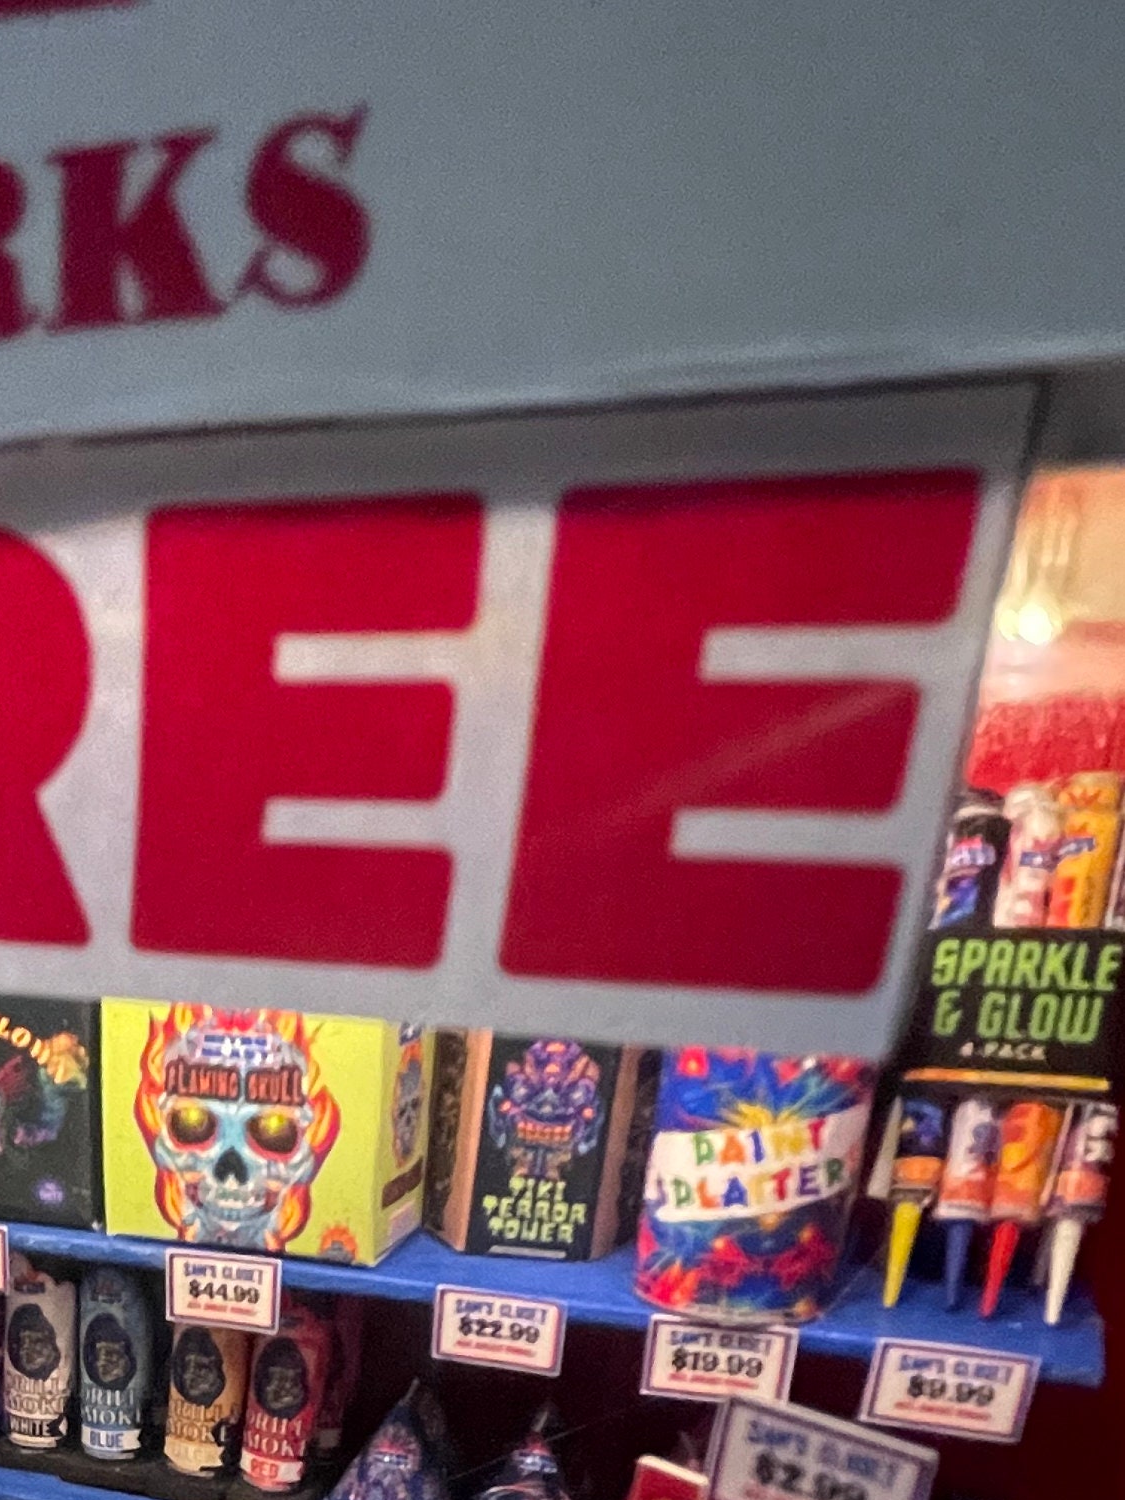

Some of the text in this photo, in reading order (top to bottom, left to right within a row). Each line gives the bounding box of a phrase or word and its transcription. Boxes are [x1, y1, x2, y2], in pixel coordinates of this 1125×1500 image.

[930, 938, 1124, 992] SPARKLE
[932, 991, 1104, 1045] & GLOW
[167, 1062, 303, 1103] FLAMING SKULL
[693, 1119, 826, 1166] PAINT
[509, 1177, 566, 1202] TIKI
[483, 1195, 587, 1225] TERROR
[489, 1217, 574, 1244] TOWER
[188, 1279, 260, 1305] $44.99
[458, 1317, 540, 1344] $22.99
[671, 1348, 763, 1377] $19.99
[907, 1375, 995, 1406] $9.99
[10, 1416, 50, 1436] WHITE
[89, 1430, 123, 1448] BLUE
[250, 1457, 279, 1478] RED
